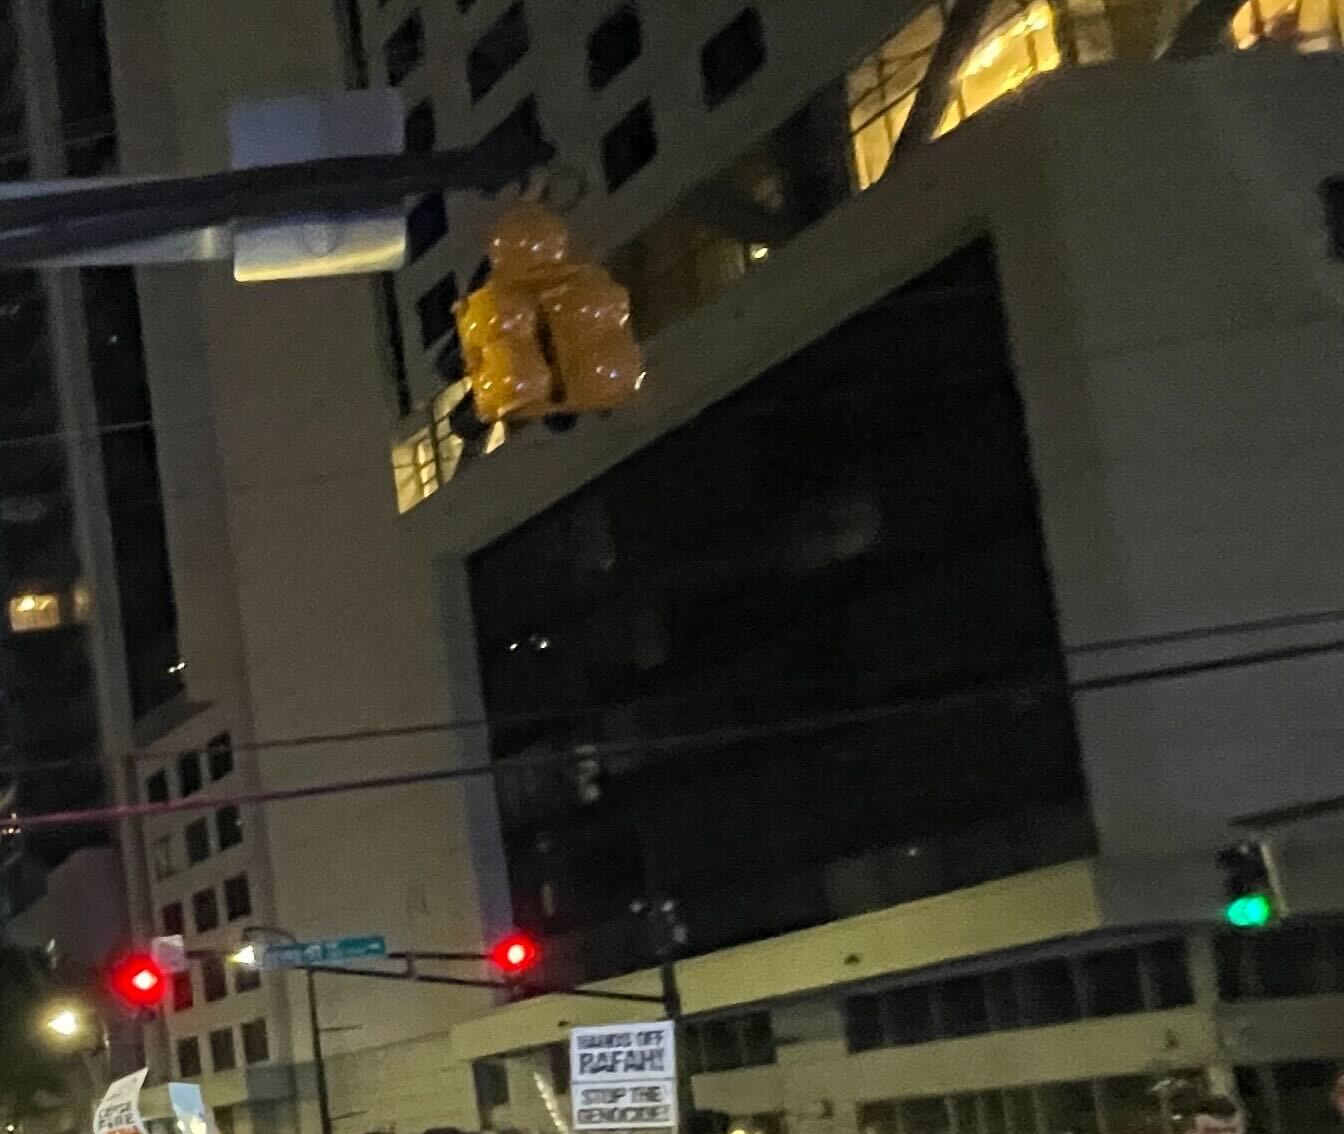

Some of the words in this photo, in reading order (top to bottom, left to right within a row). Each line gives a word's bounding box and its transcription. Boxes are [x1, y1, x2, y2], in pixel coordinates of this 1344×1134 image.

[579, 1048, 665, 1075] RAFAH!
[580, 1087, 627, 1105] STOP
[630, 1086, 662, 1103] THE
